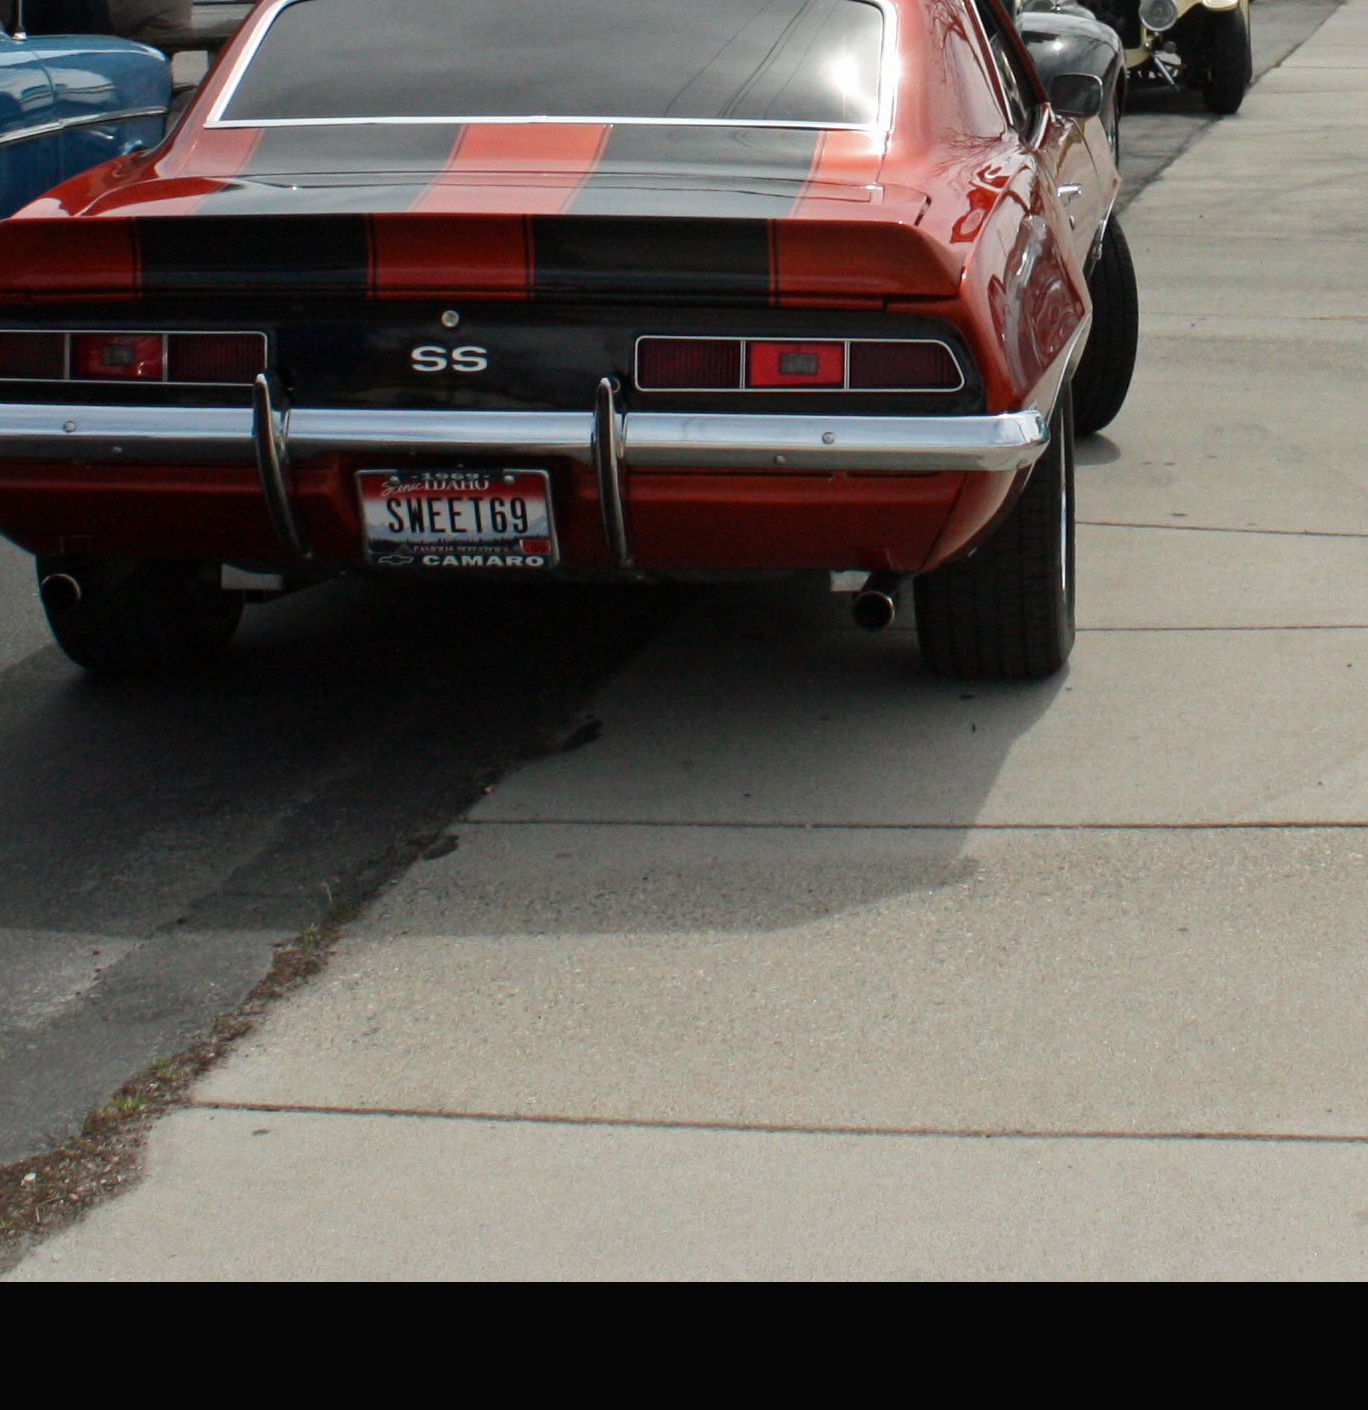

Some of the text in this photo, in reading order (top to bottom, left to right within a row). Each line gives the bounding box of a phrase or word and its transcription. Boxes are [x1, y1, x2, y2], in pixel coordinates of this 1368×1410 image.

[411, 345, 488, 372] SS
[423, 479, 490, 491] IDAHO
[386, 496, 529, 534] SWEET69
[422, 554, 545, 566] CAMARO
